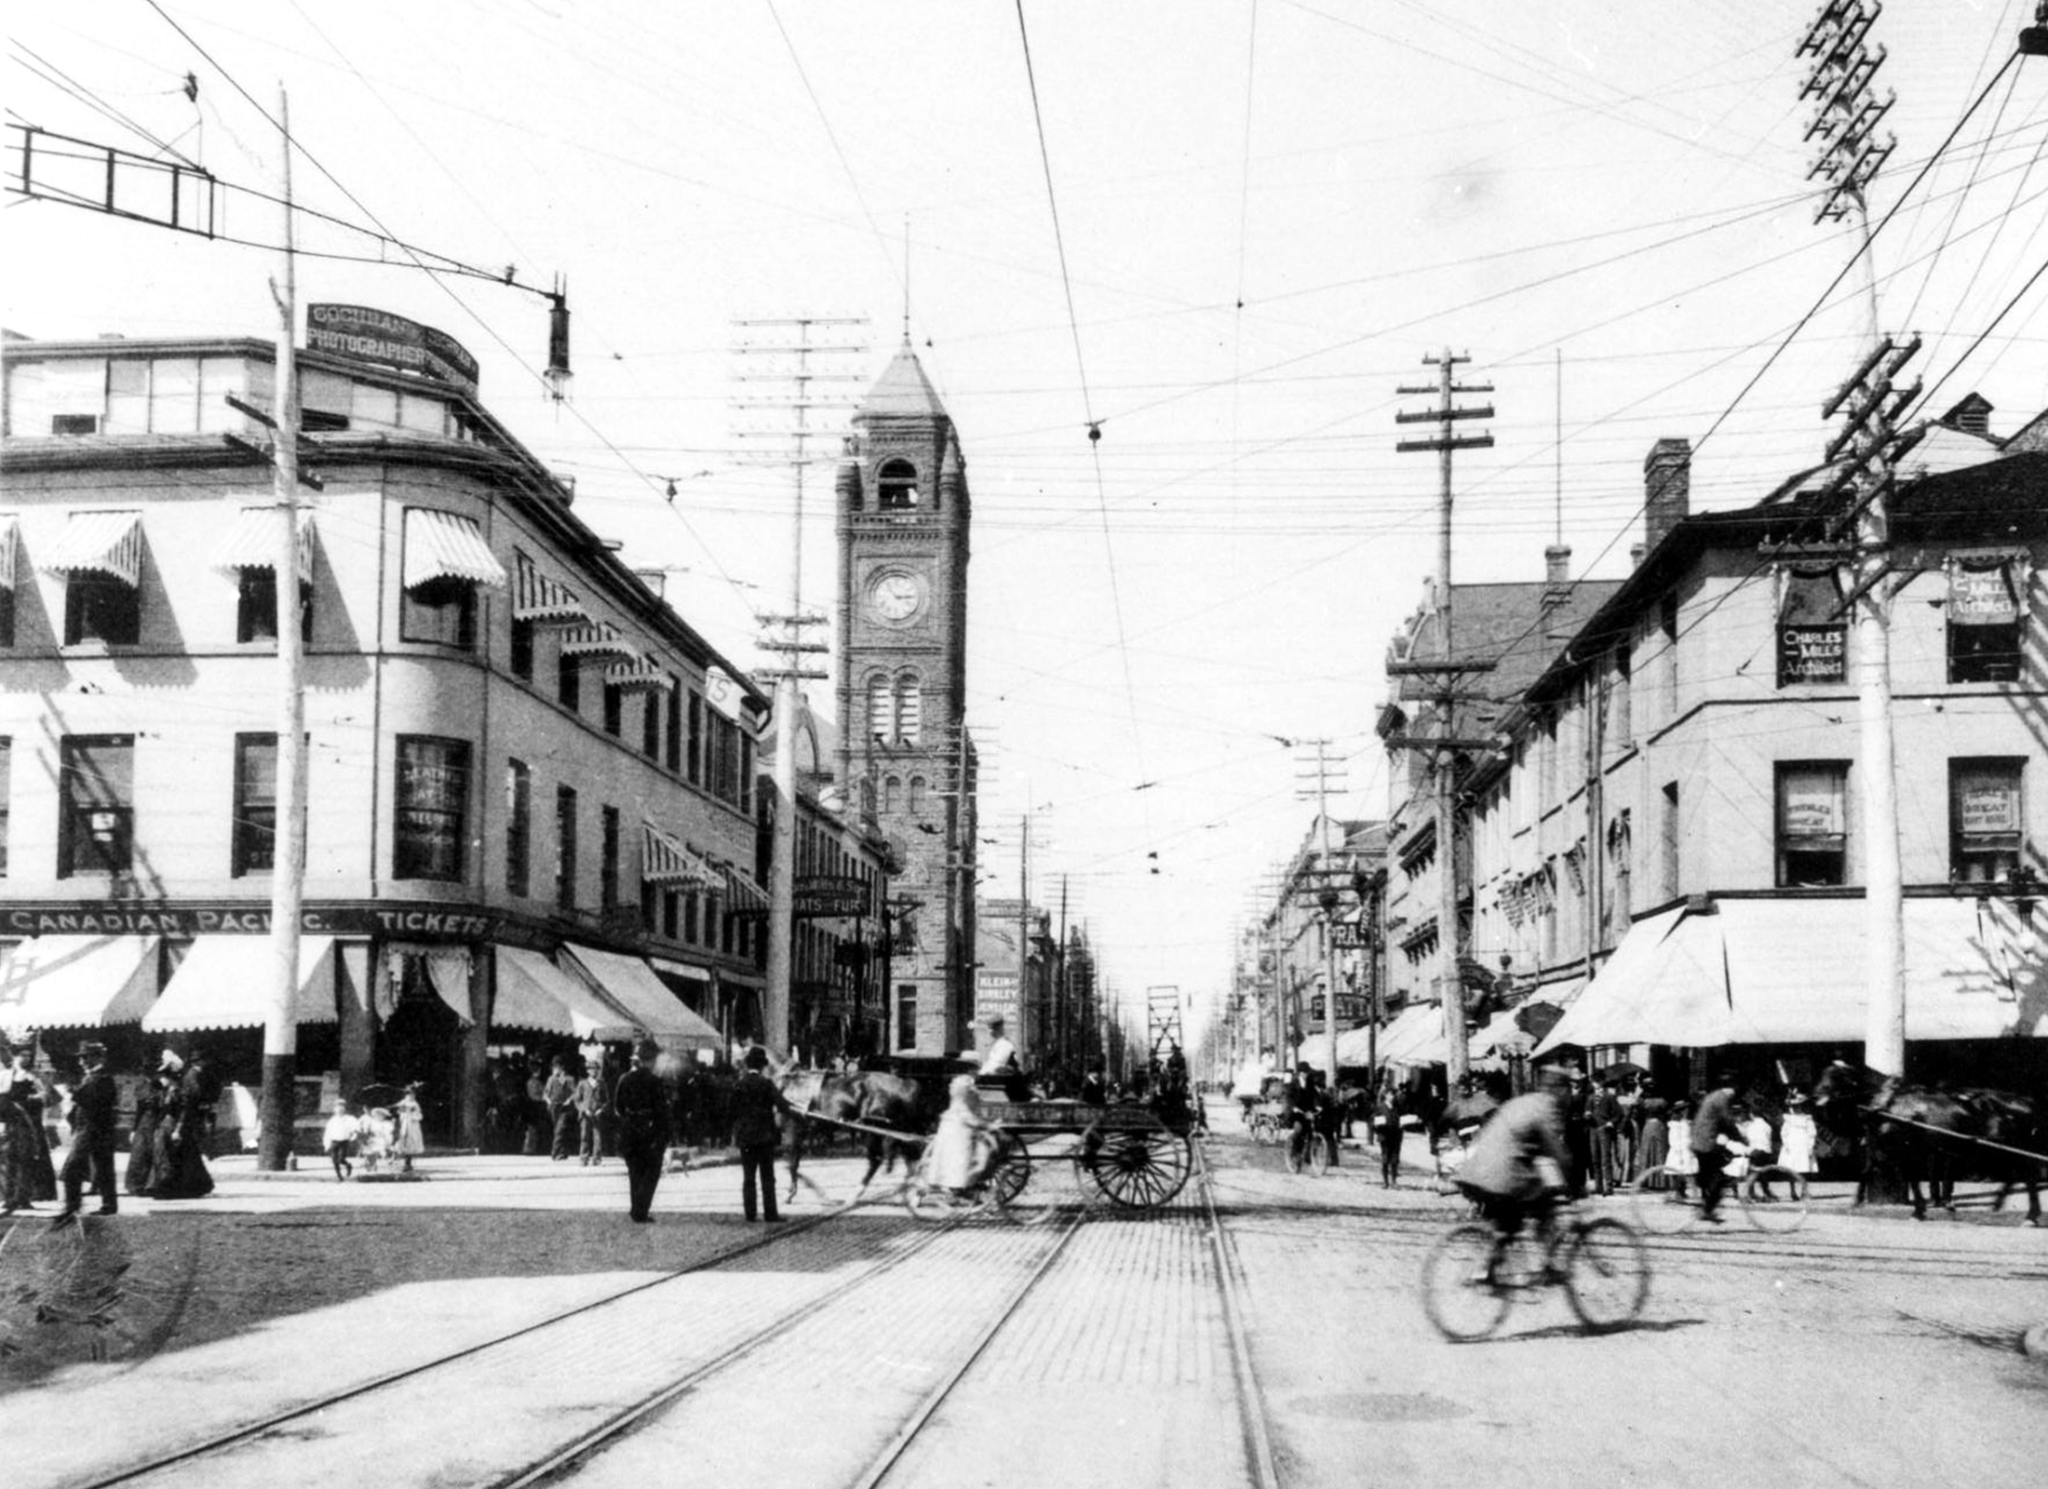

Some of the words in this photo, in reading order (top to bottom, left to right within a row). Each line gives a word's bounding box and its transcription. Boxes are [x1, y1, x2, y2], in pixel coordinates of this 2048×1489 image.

[307, 328, 426, 365] PHOTOGRAPHER
[1801, 644, 1841, 659] MILLS
[11, 911, 179, 930] CANADIAN
[197, 911, 330, 930] PACIC.
[377, 911, 488, 935] TICKETS
